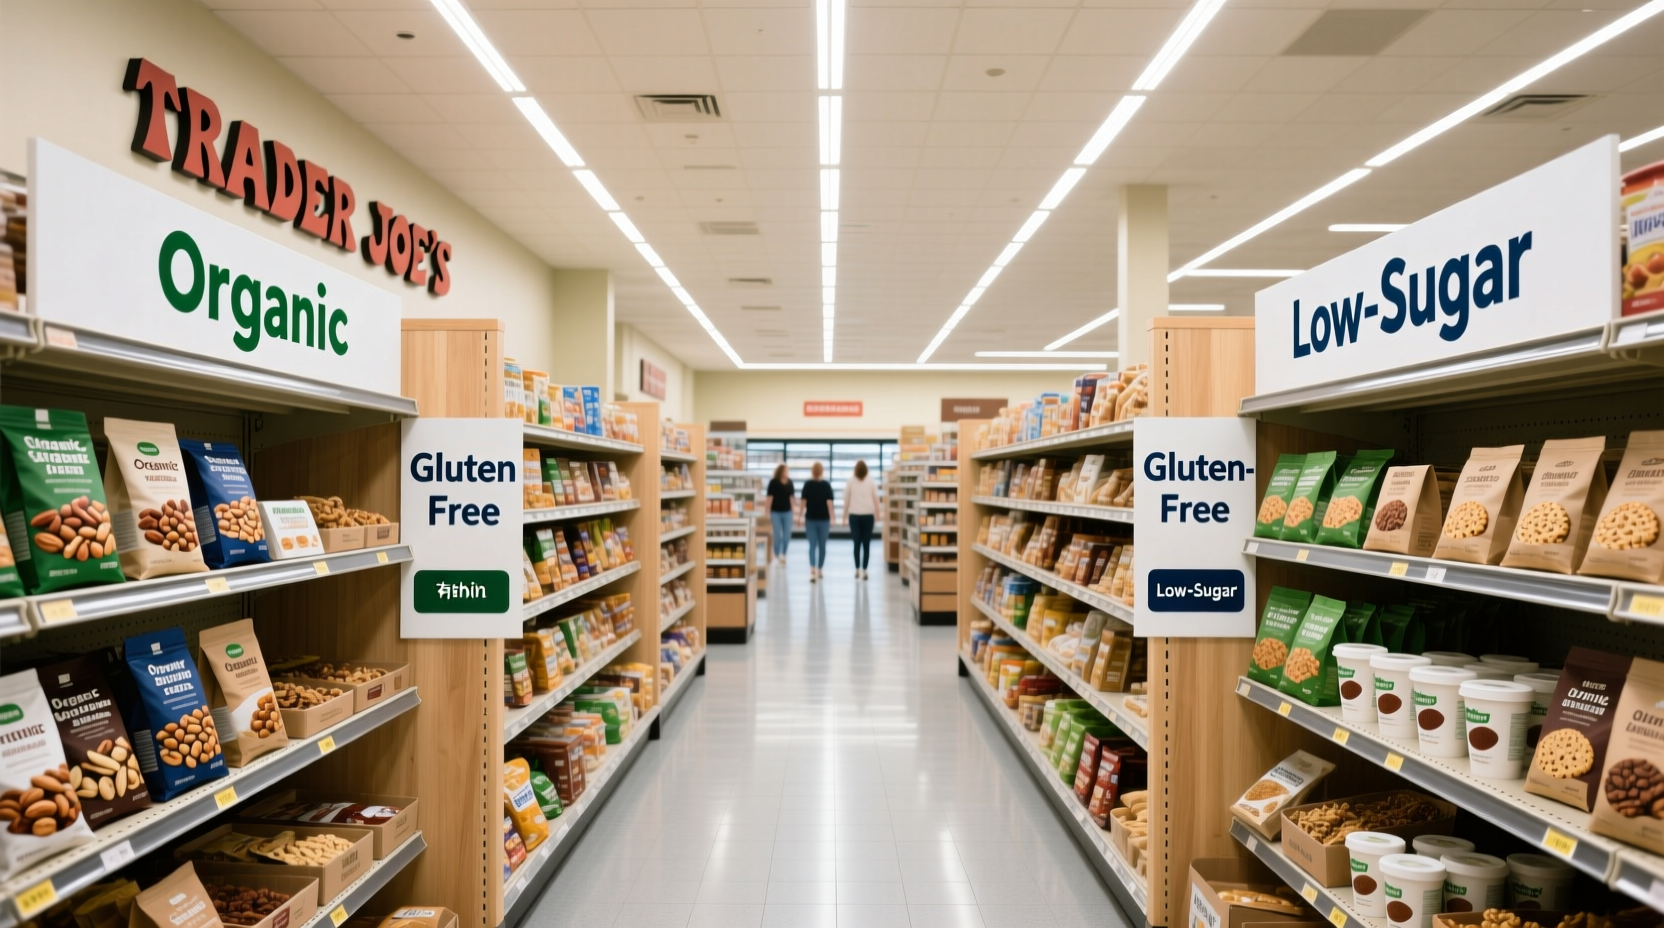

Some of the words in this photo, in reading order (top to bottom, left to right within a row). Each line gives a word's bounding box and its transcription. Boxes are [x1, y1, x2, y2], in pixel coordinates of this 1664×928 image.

[123, 58, 356, 252] TRADER
[361, 201, 452, 297] JOE'S
[158, 230, 349, 356] Organic
[1293, 230, 1533, 359] Low-Sugar
[410, 452, 516, 483] Gluten
[1143, 451, 1255, 482] Gluten-
[428, 495, 501, 526] Free
[1161, 493, 1230, 524] Free
[1156, 583, 1238, 602] Low-Sugar
